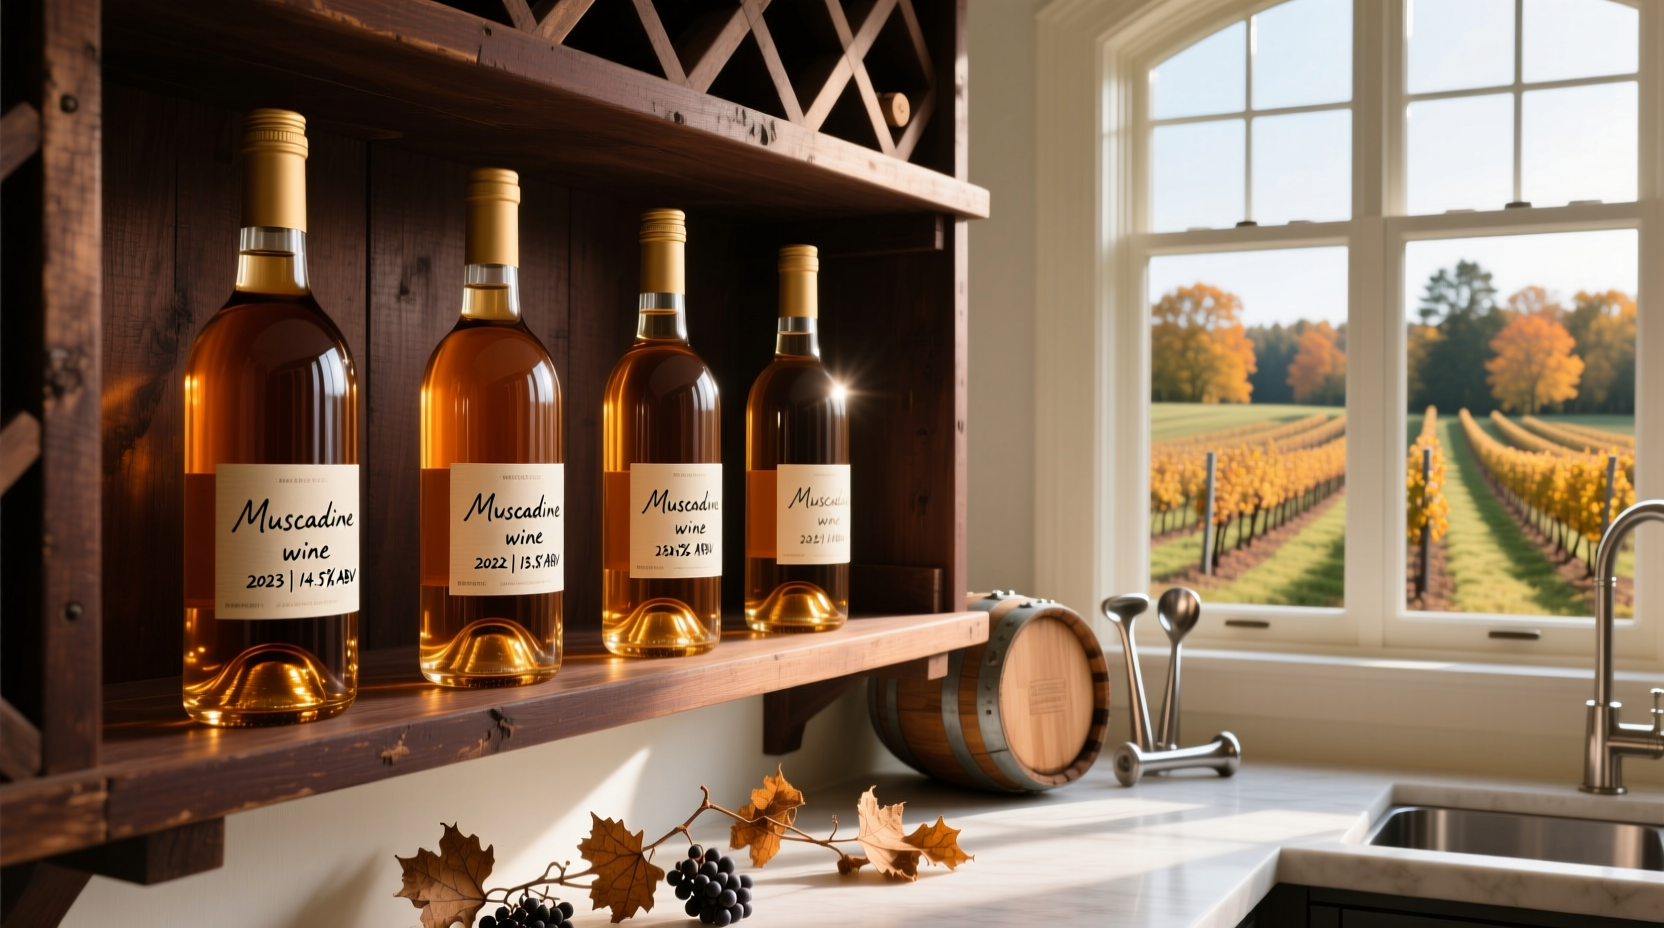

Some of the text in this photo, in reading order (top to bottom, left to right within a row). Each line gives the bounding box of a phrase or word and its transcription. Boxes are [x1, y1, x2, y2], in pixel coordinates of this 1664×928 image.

[231, 498, 354, 533] Muscadine
[463, 492, 560, 522] Muscadine
[675, 520, 706, 535] wine
[506, 529, 544, 546] wine
[283, 541, 331, 561] wine
[474, 557, 508, 570] 2022
[246, 573, 285, 589] 2023
